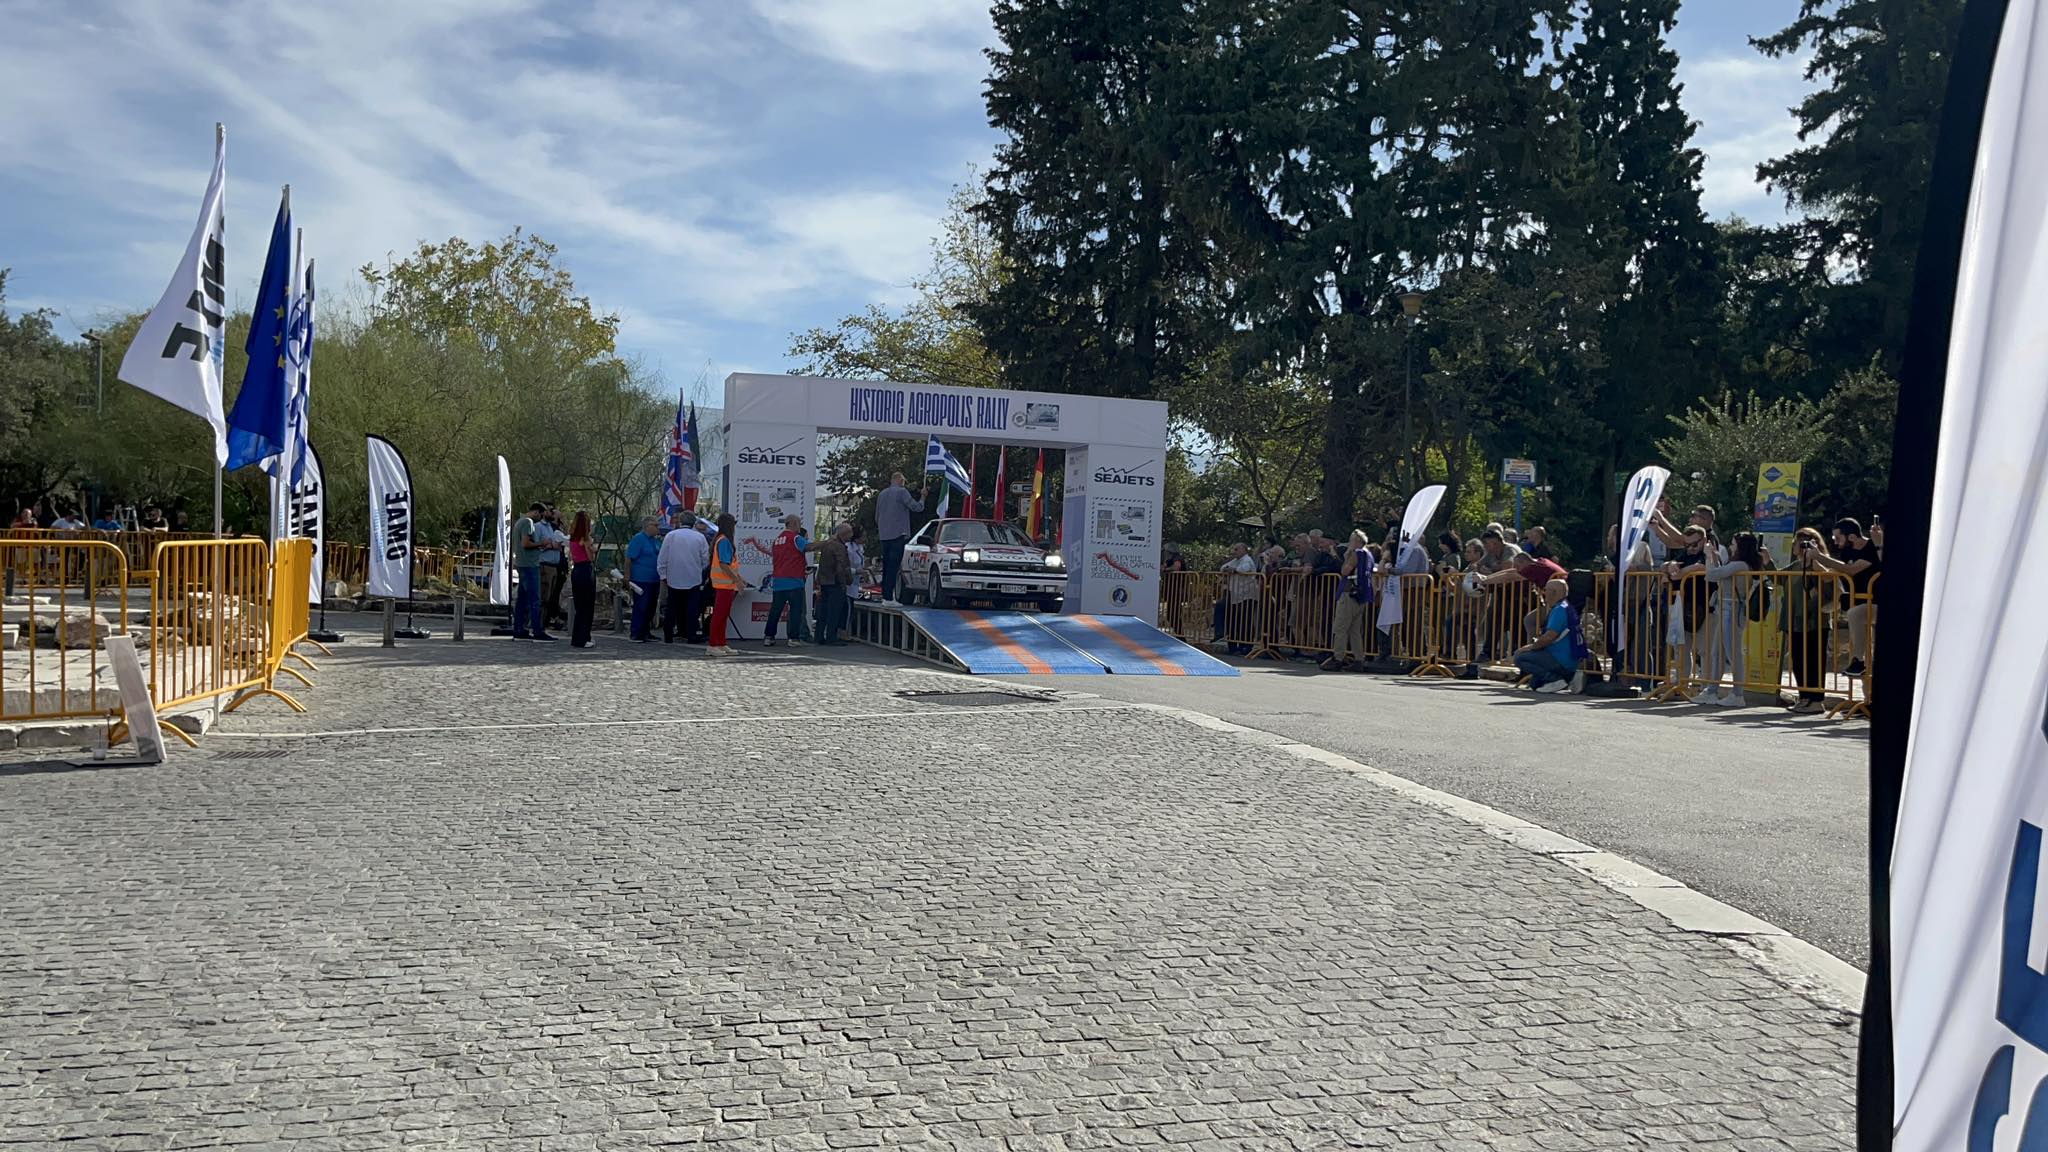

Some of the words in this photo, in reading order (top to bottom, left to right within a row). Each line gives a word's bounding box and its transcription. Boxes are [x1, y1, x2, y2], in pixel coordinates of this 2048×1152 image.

[850, 387, 904, 424] HISTORIC
[908, 391, 973, 428] ACROPOLIS
[976, 396, 1010, 431] RALLY
[738, 453, 806, 466] SEAJETS
[1094, 472, 1155, 487] SEAJETS
